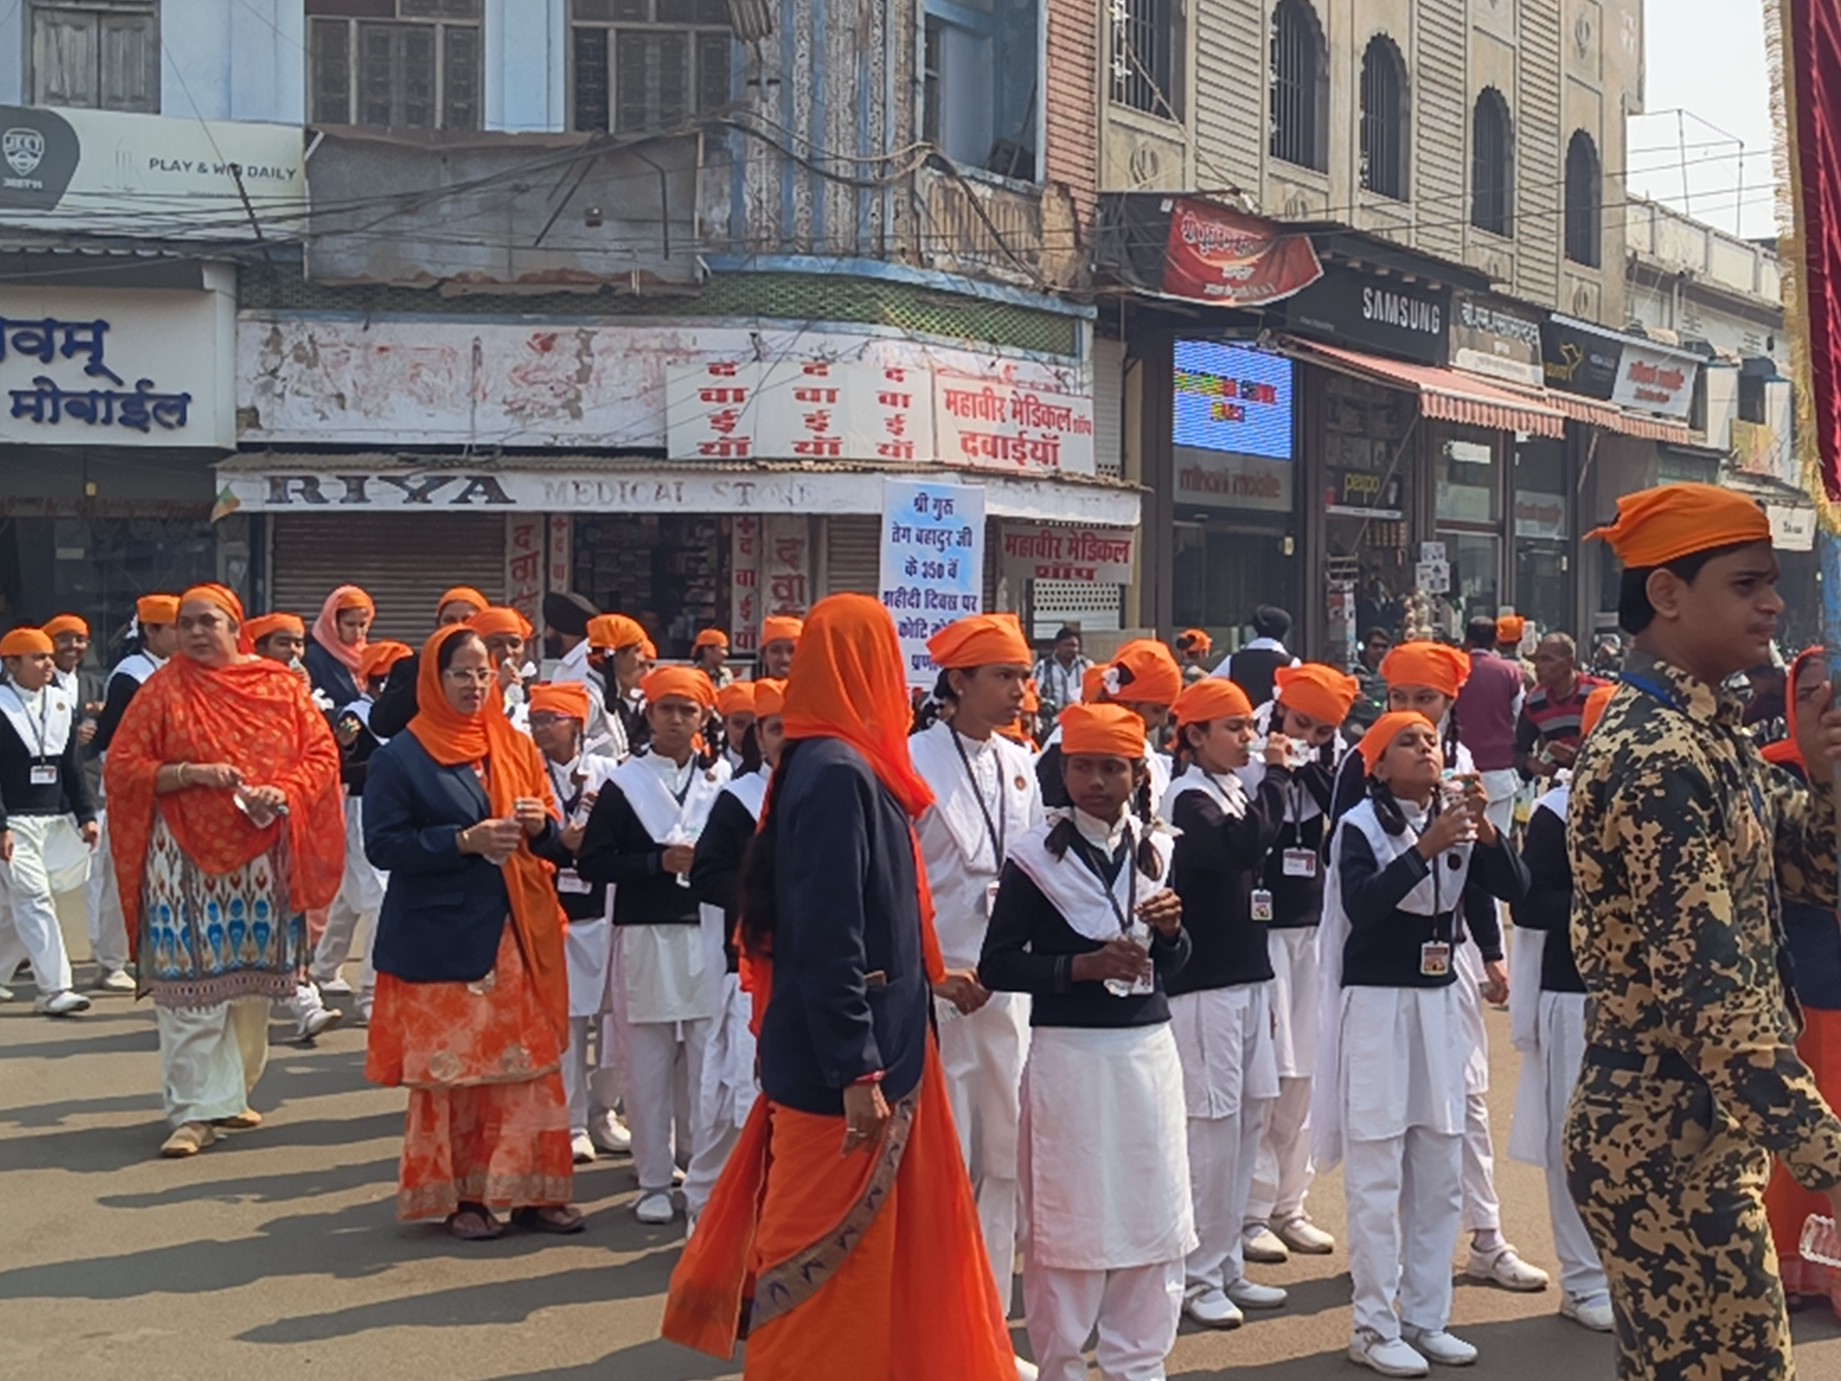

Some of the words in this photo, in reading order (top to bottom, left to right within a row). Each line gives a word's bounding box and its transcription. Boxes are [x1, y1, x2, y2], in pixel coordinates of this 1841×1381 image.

[149, 157, 193, 173] PLAY
[196, 161, 208, 174] &
[248, 165, 297, 181] DAILY
[1363, 286, 1441, 335] SAMSUNG
[944, 387, 1007, 424] महावीर
[1010, 390, 1073, 432] मेडिकल
[265, 475, 517, 504] RIYA
[913, 492, 929, 513] श्री
[892, 521, 912, 543] तेग
[956, 526, 973, 548] जी
[1005, 529, 1065, 559] महावीर
[1068, 529, 1132, 563] मेडिकल
[905, 555, 918, 577] के
[922, 560, 945, 579] 350
[924, 588, 958, 611] दिवस
[962, 594, 978, 612] पर
